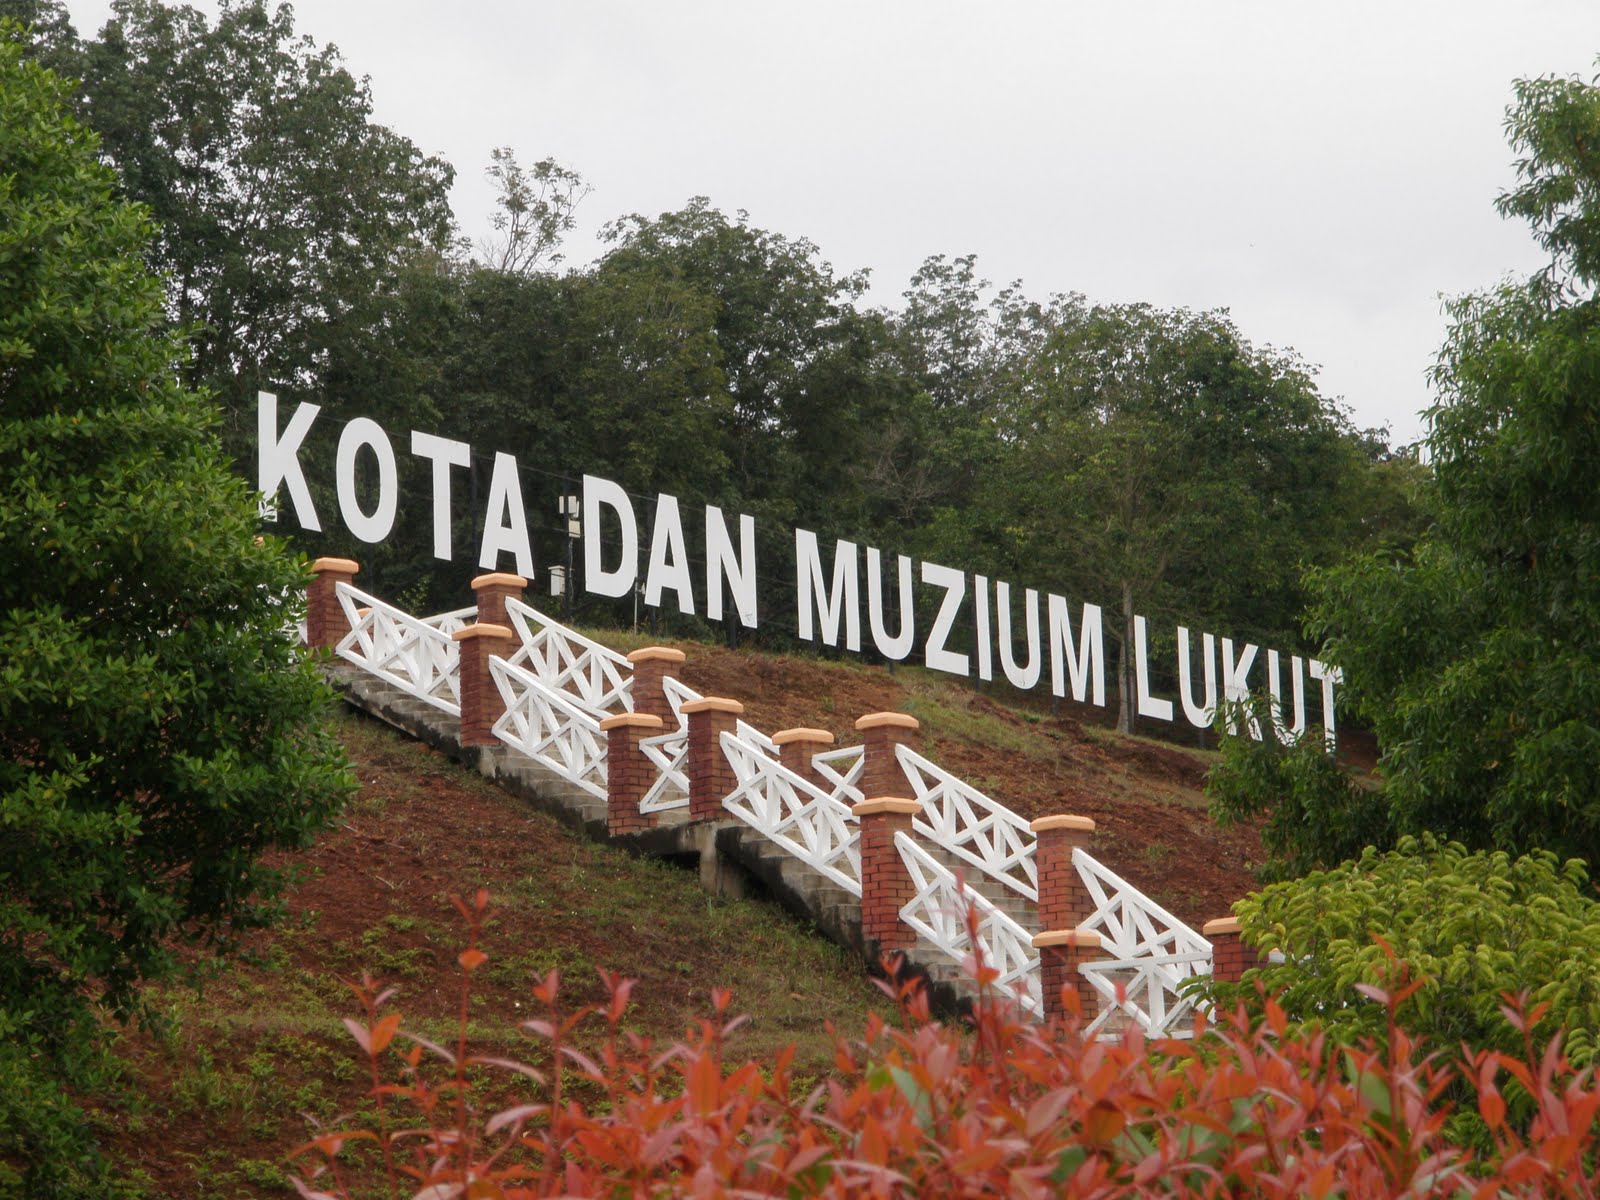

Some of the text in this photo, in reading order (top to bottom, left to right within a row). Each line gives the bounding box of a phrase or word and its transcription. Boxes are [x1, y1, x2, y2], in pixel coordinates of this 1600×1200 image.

[258, 390, 1344, 753] KOTA DAN MUZIUM LUKUT
